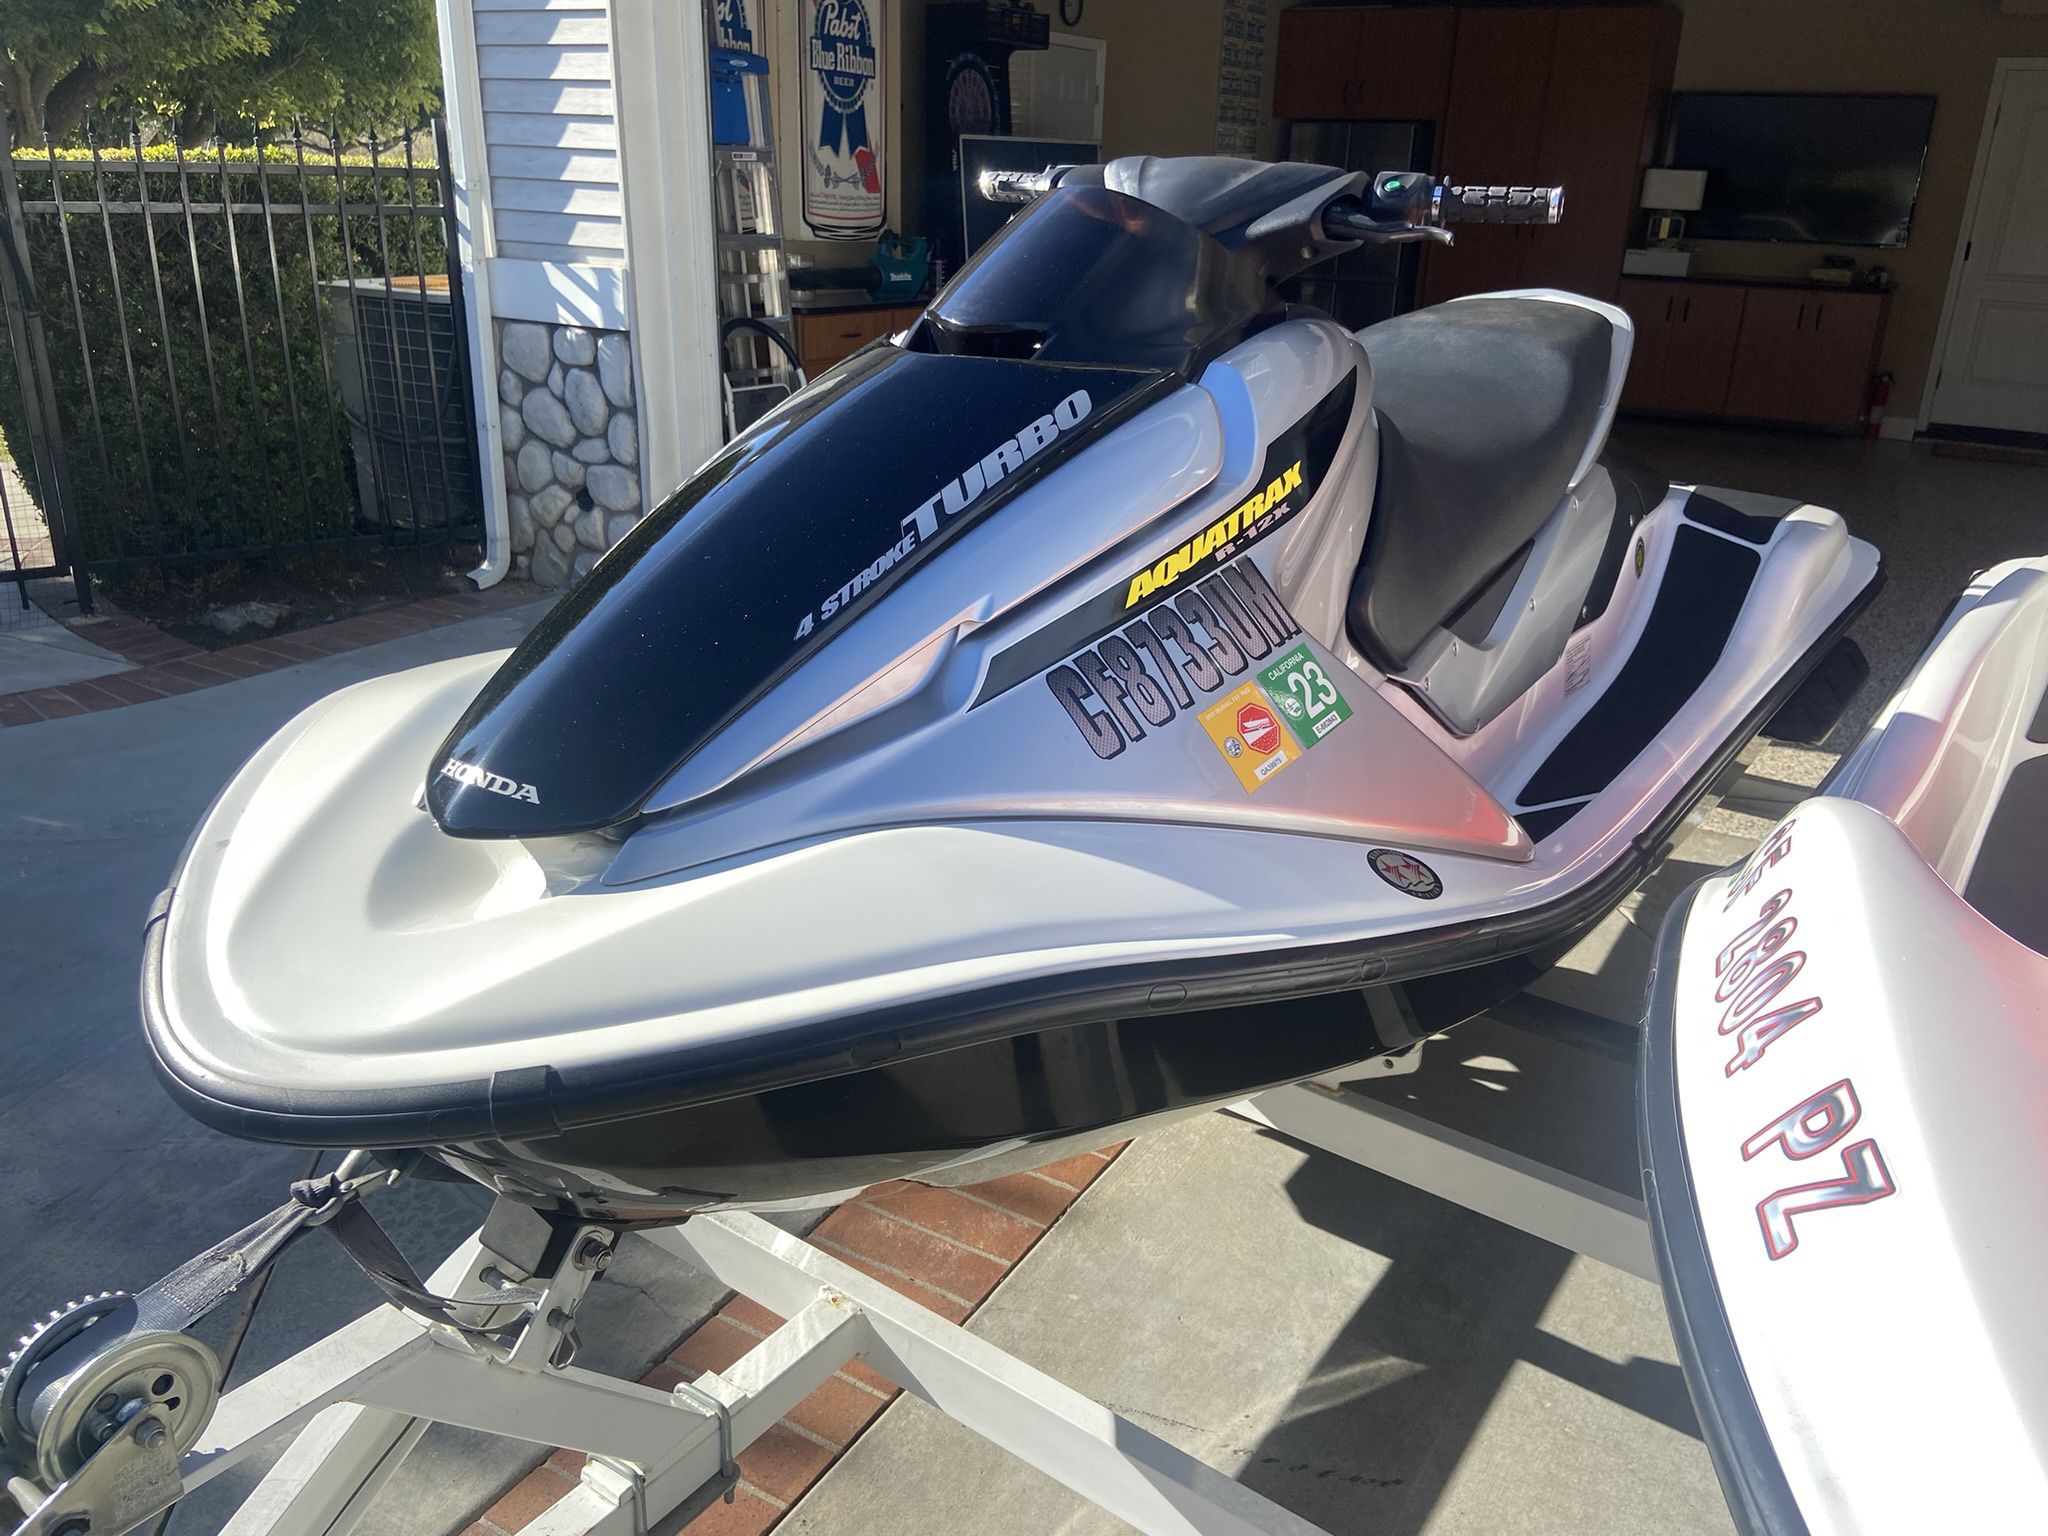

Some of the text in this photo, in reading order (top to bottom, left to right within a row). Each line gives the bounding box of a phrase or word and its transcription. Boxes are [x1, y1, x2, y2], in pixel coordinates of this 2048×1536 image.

[823, 0, 862, 40] Pabst
[811, 39, 875, 77] Blue Ribbon
[833, 76, 855, 87] BEER
[793, 389, 1092, 641] 4 STROKE TURBO
[1125, 460, 1303, 609] AQUATRAX
[1214, 501, 1291, 562] R-12X
[1045, 554, 1302, 761] CF8733UM
[1268, 652, 1305, 681] CALIFORNIA
[1287, 661, 1337, 719] 23
[440, 758, 541, 805] HONDA
[1715, 888, 1823, 1078] 2804
[1741, 1077, 1897, 1261] PZ
